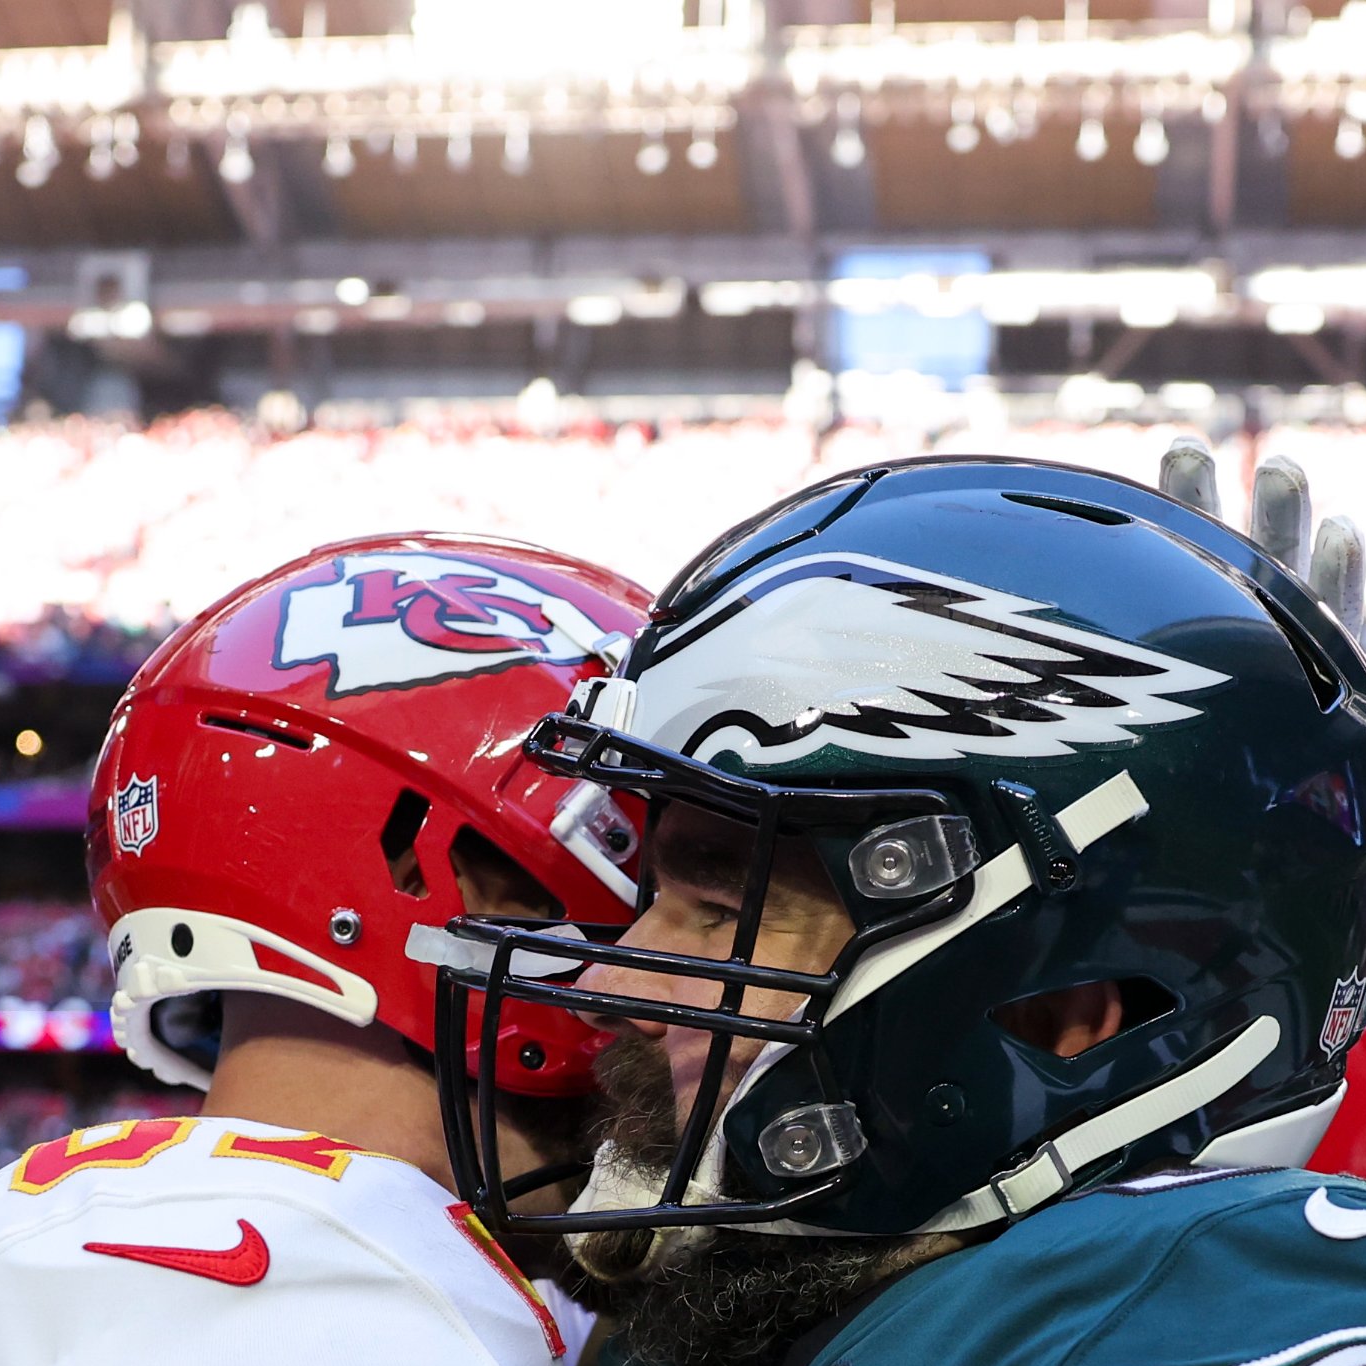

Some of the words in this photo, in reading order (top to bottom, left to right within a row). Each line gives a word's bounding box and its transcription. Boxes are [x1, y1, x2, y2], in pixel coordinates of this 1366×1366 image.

[343, 569, 554, 653] KC
[121, 807, 152, 843] NFL
[1324, 1009, 1353, 1045] NFL
